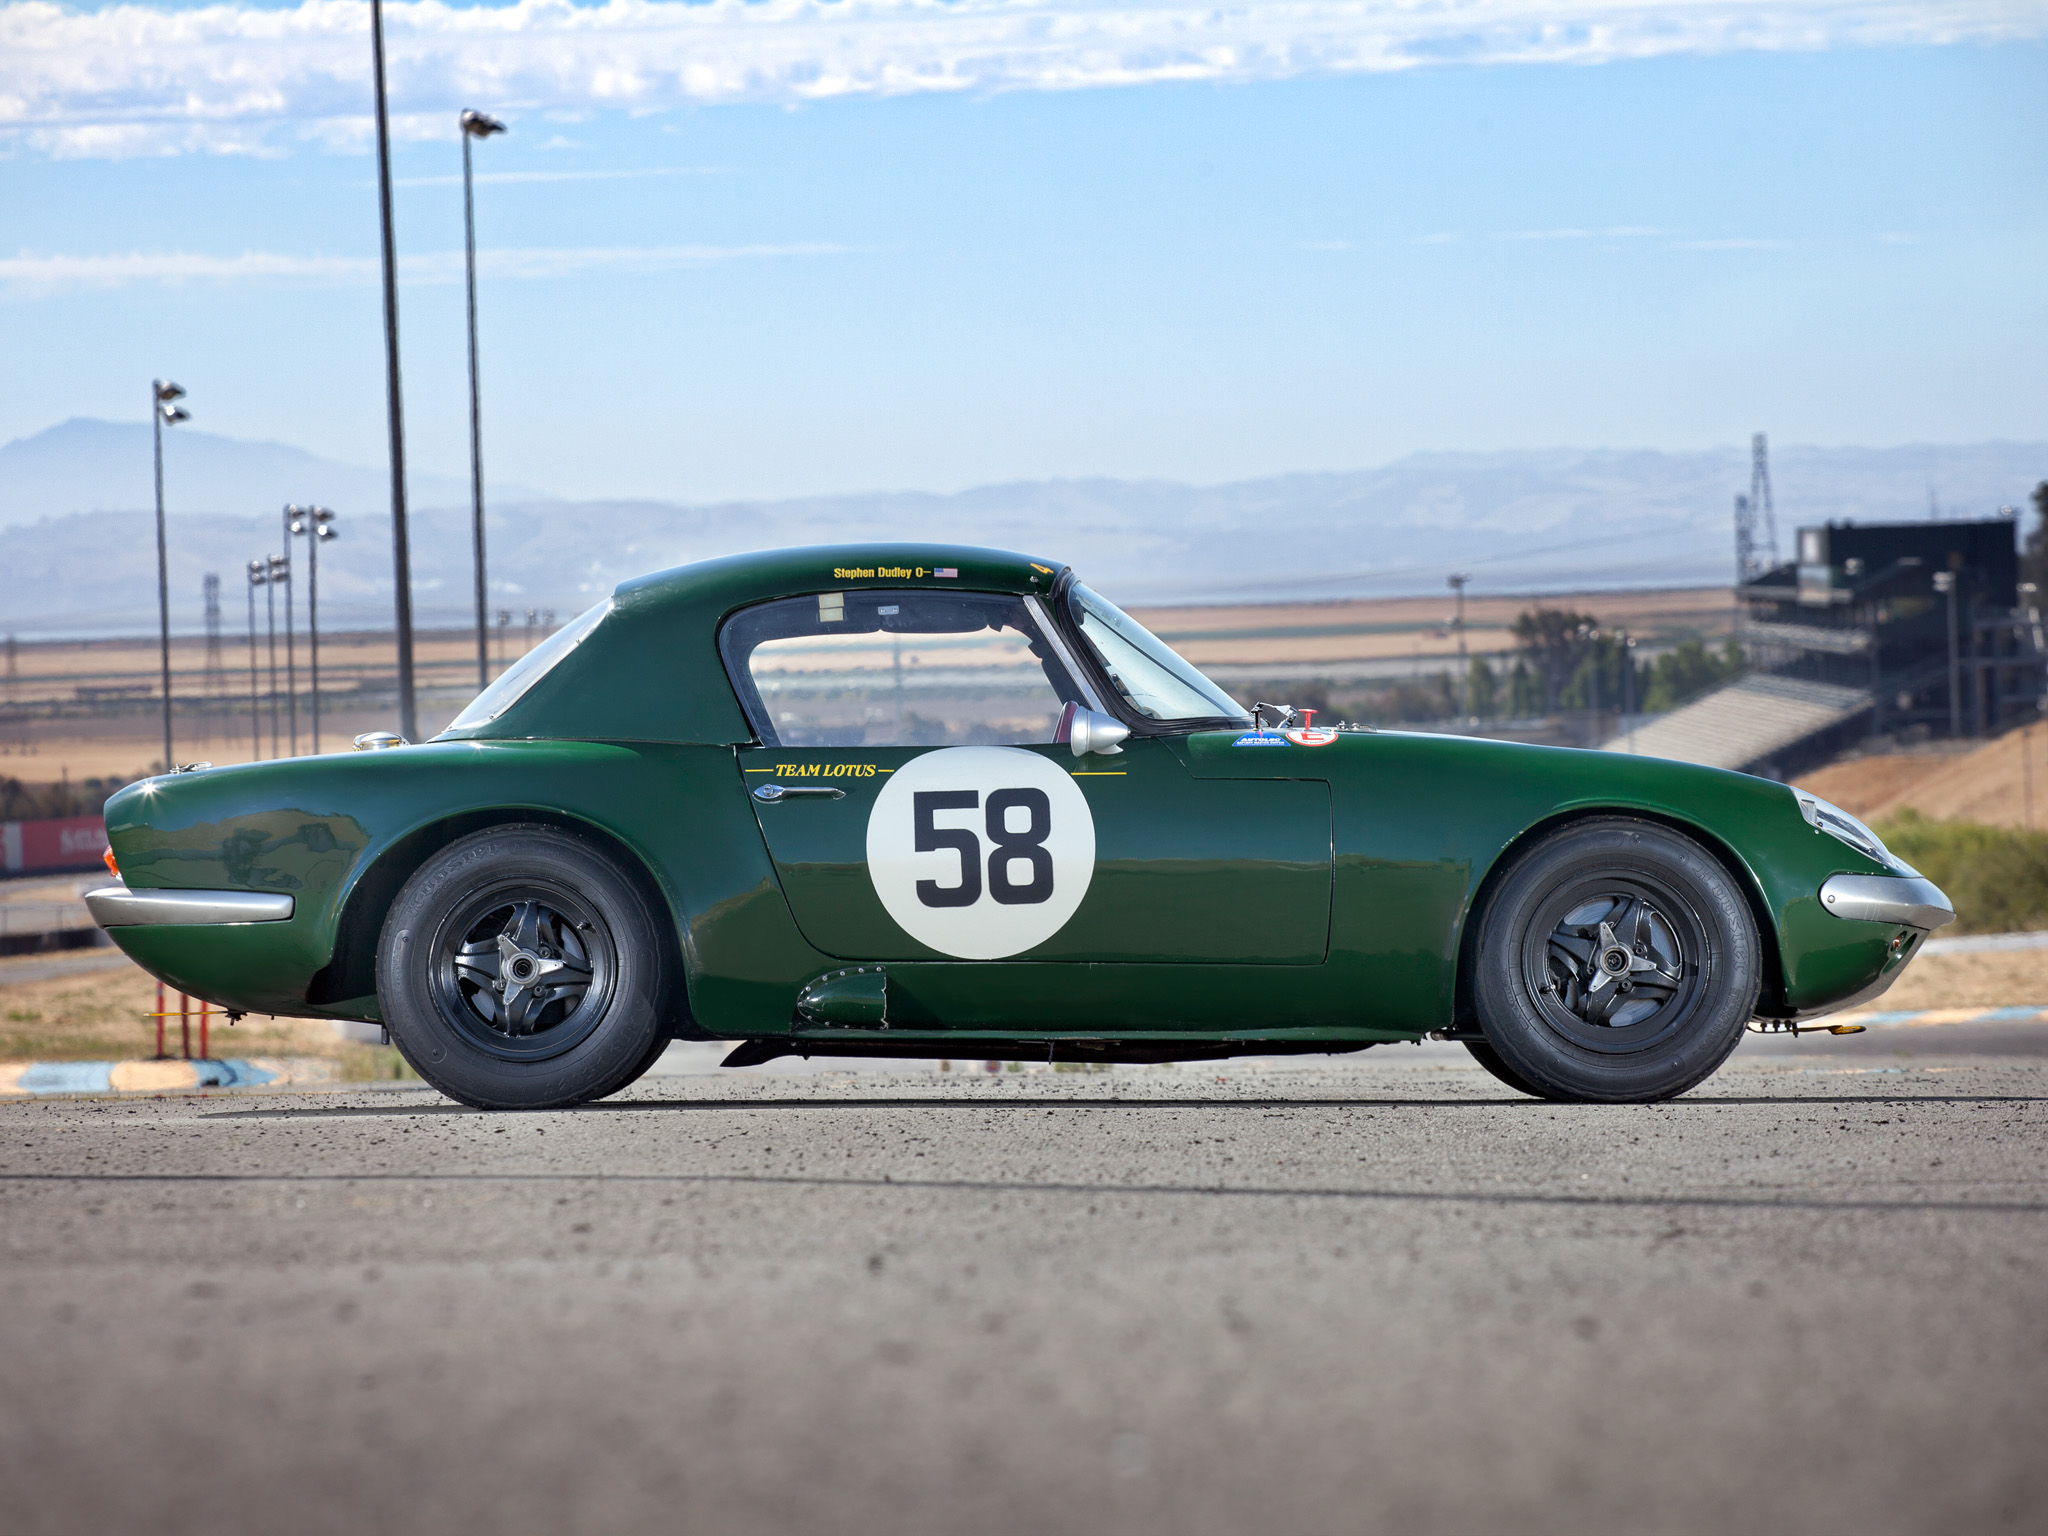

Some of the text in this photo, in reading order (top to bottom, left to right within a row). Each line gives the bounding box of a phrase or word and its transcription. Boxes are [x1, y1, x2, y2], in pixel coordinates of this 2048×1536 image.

[834, 567, 875, 579] Stephen
[878, 567, 911, 579] Dudley
[775, 764, 876, 777] TEAM LOTUS
[913, 787, 1054, 908] 58
[1691, 864, 1750, 975] Hoosier
